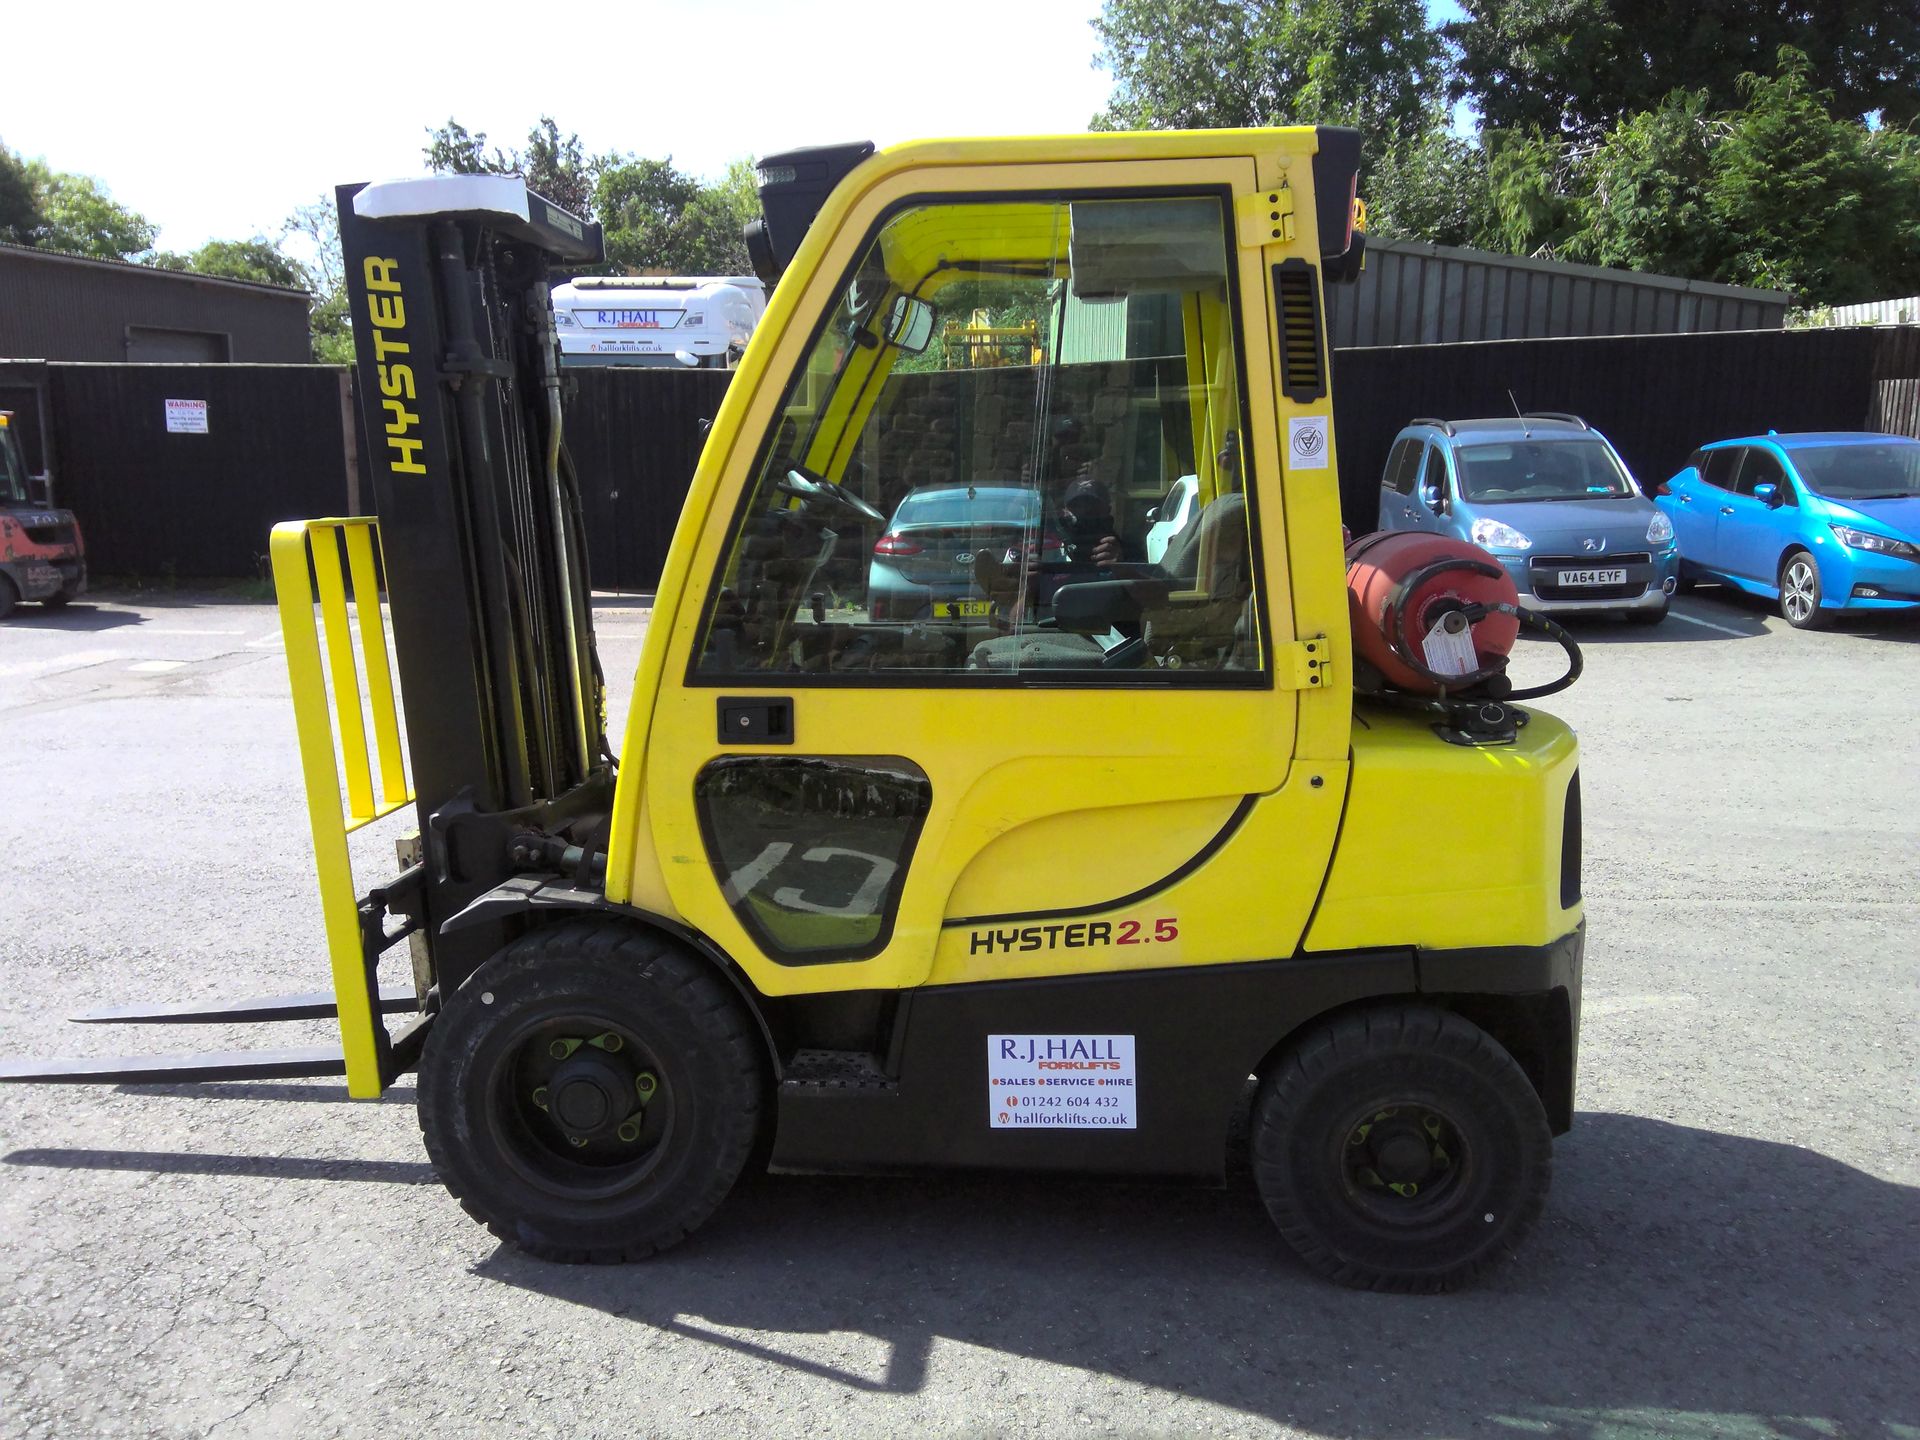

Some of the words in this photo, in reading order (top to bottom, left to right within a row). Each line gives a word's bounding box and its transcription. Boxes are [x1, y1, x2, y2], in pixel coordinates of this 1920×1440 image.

[598, 311, 657, 325] R.J.HALL
[363, 256, 427, 475] HYSTER
[168, 401, 205, 409] WARNING
[1564, 572, 1595, 584] VA64
[1599, 571, 1621, 582] EYF
[964, 603, 986, 614] RGJ
[970, 922, 1112, 955] HYSTER
[1116, 918, 1179, 945] 2.5
[1001, 1039, 1121, 1063] R.J.HALL
[1038, 1061, 1121, 1070] FORKLIFTS
[1000, 1078, 1036, 1086] SALES
[1046, 1078, 1095, 1086] SERVICE
[1105, 1078, 1133, 1086] HIRE
[1022, 1097, 1062, 1107] 01242
[1066, 1097, 1090, 1107] 604
[1095, 1097, 1119, 1107] 432
[1014, 1112, 1128, 1125] hallforklifts.co.uk
